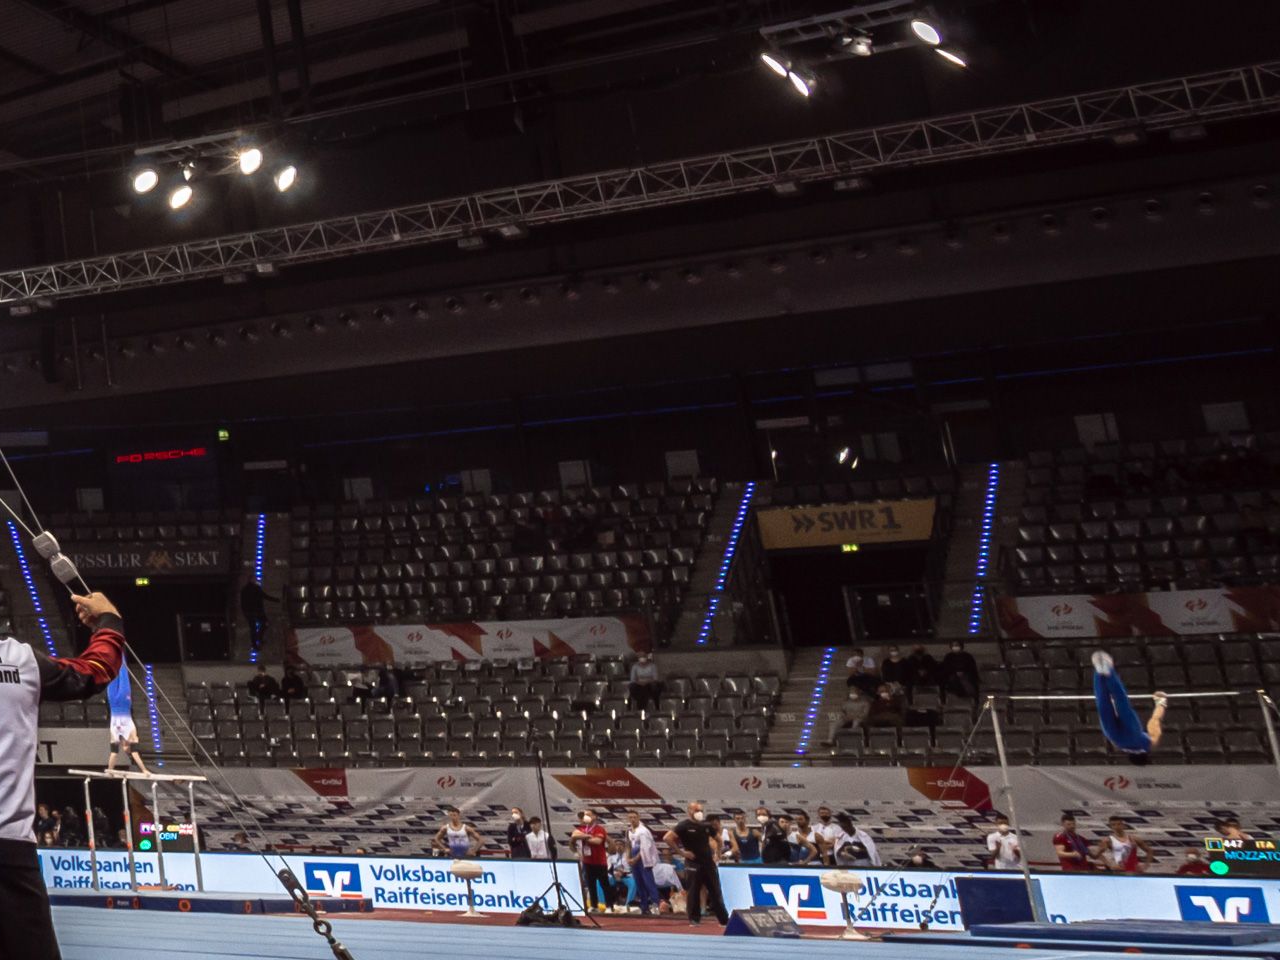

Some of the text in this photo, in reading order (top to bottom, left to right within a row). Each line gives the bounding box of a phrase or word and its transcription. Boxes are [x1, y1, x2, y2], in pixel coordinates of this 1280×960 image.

[115, 447, 207, 464] PORSCHE
[74, 551, 220, 568] ESSLER SEKT
